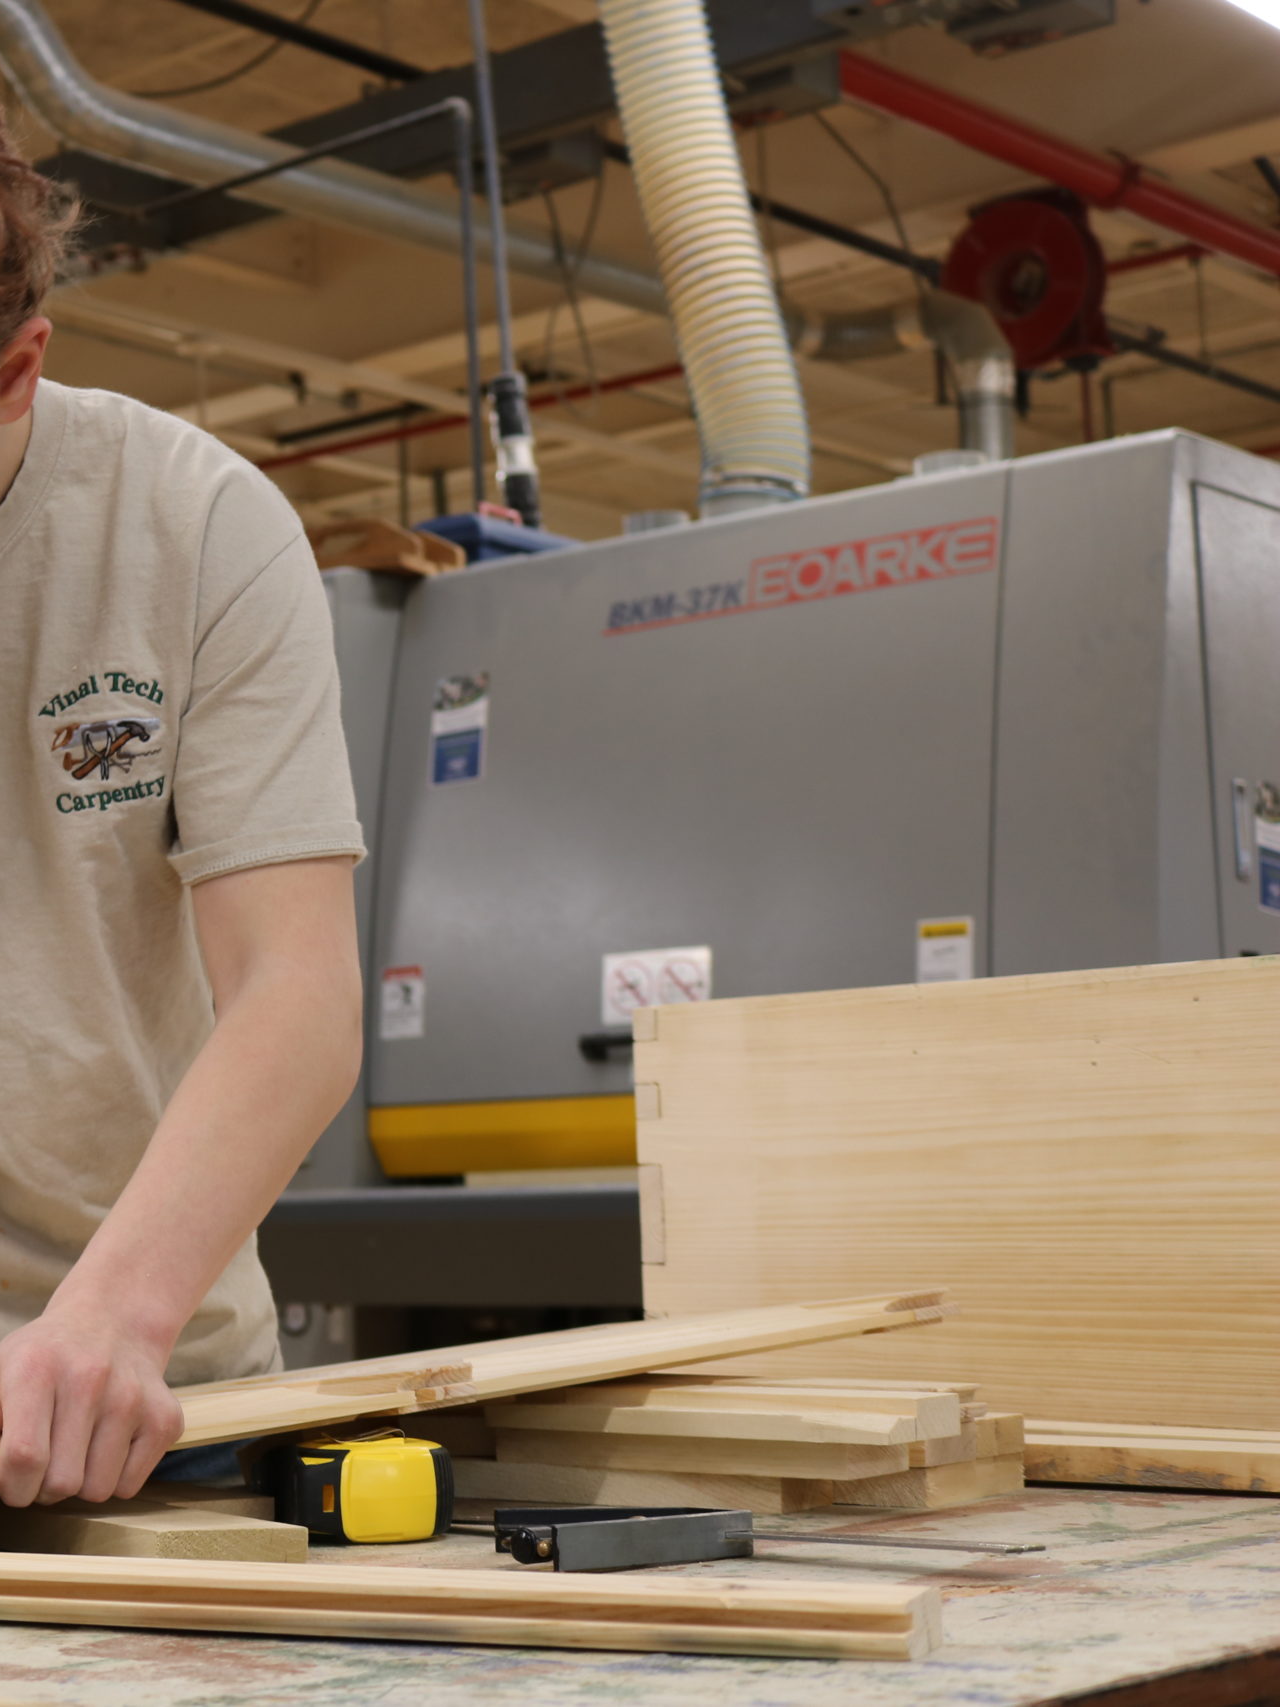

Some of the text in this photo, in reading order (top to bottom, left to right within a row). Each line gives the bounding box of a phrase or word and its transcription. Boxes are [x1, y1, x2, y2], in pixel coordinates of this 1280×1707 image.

[38, 671, 165, 718] Vinal Tech
[55, 775, 166, 814] Carpentry
